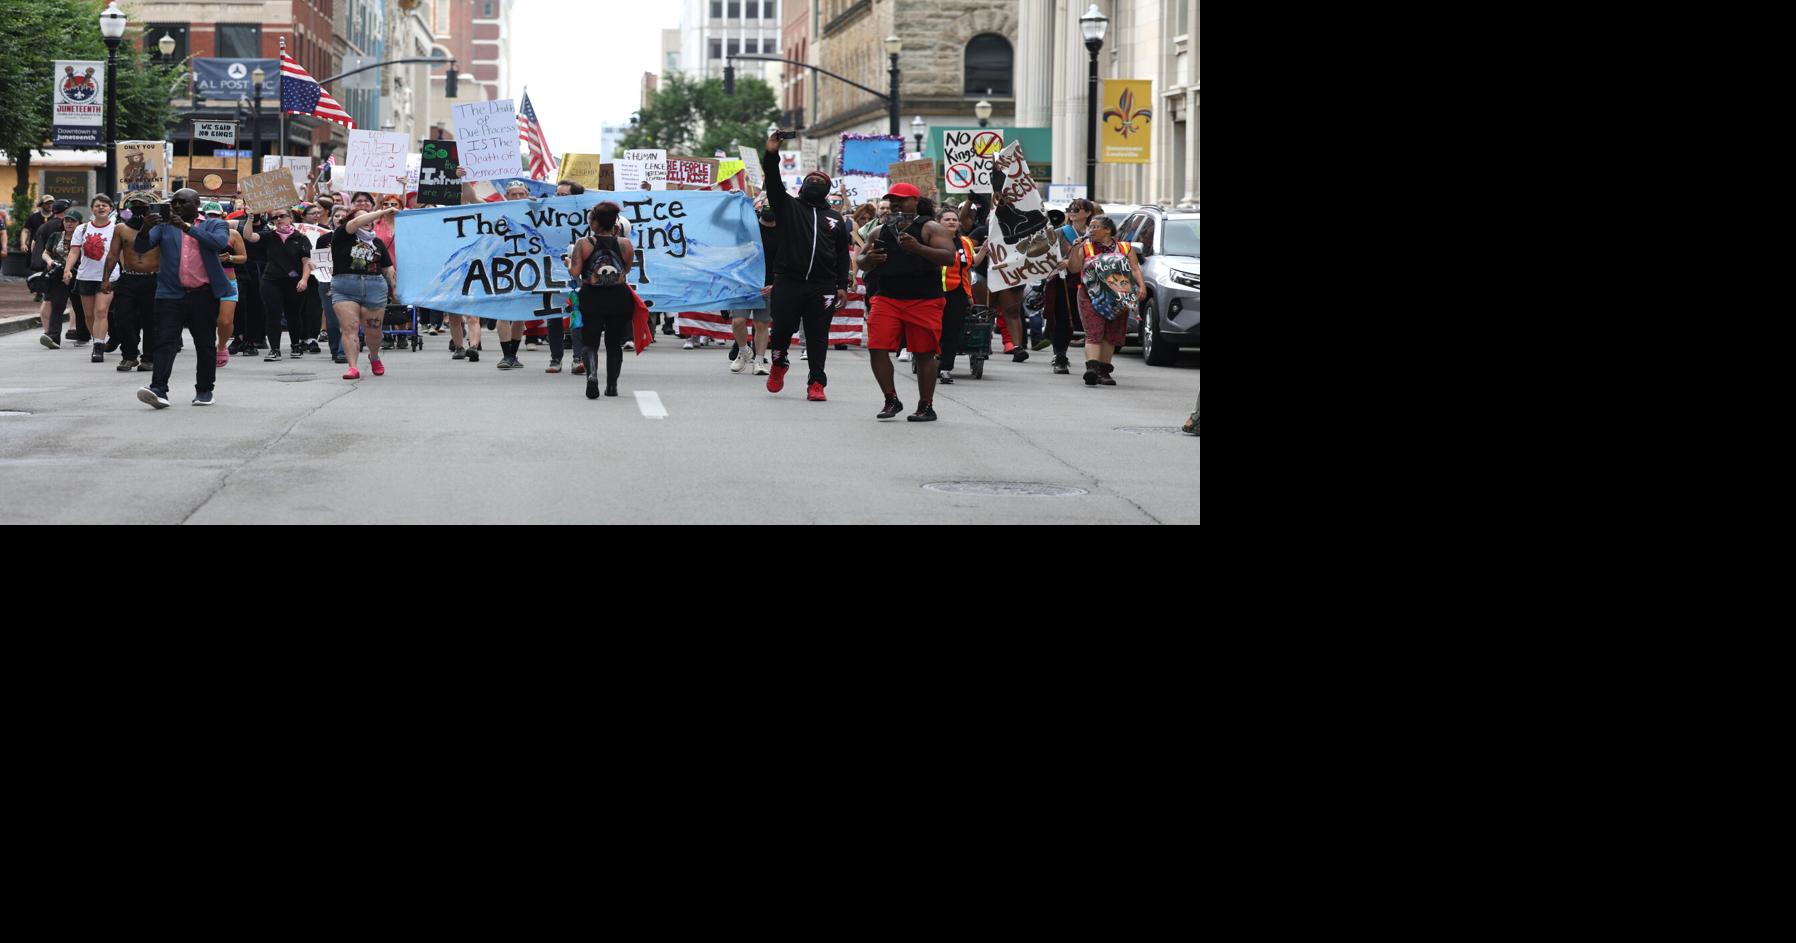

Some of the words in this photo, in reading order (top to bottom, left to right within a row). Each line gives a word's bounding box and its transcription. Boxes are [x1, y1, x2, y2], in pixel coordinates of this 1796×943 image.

[220, 80, 249, 89] POST
[56, 104, 102, 113] JUNETEENTH
[456, 103, 485, 118] The
[210, 130, 233, 138] KINGS
[945, 131, 971, 147] NO
[422, 143, 449, 160] So
[632, 151, 658, 161] HUMAN
[944, 147, 976, 165] Kings
[679, 160, 709, 174] PEOPLE
[973, 158, 993, 171] NO
[55, 176, 78, 185] PNC
[686, 171, 709, 184] RISE
[47, 185, 85, 194] TOWER
[443, 213, 512, 238] The
[623, 198, 688, 224] Ice
[504, 233, 542, 257] Is
[987, 242, 1008, 265] NO
